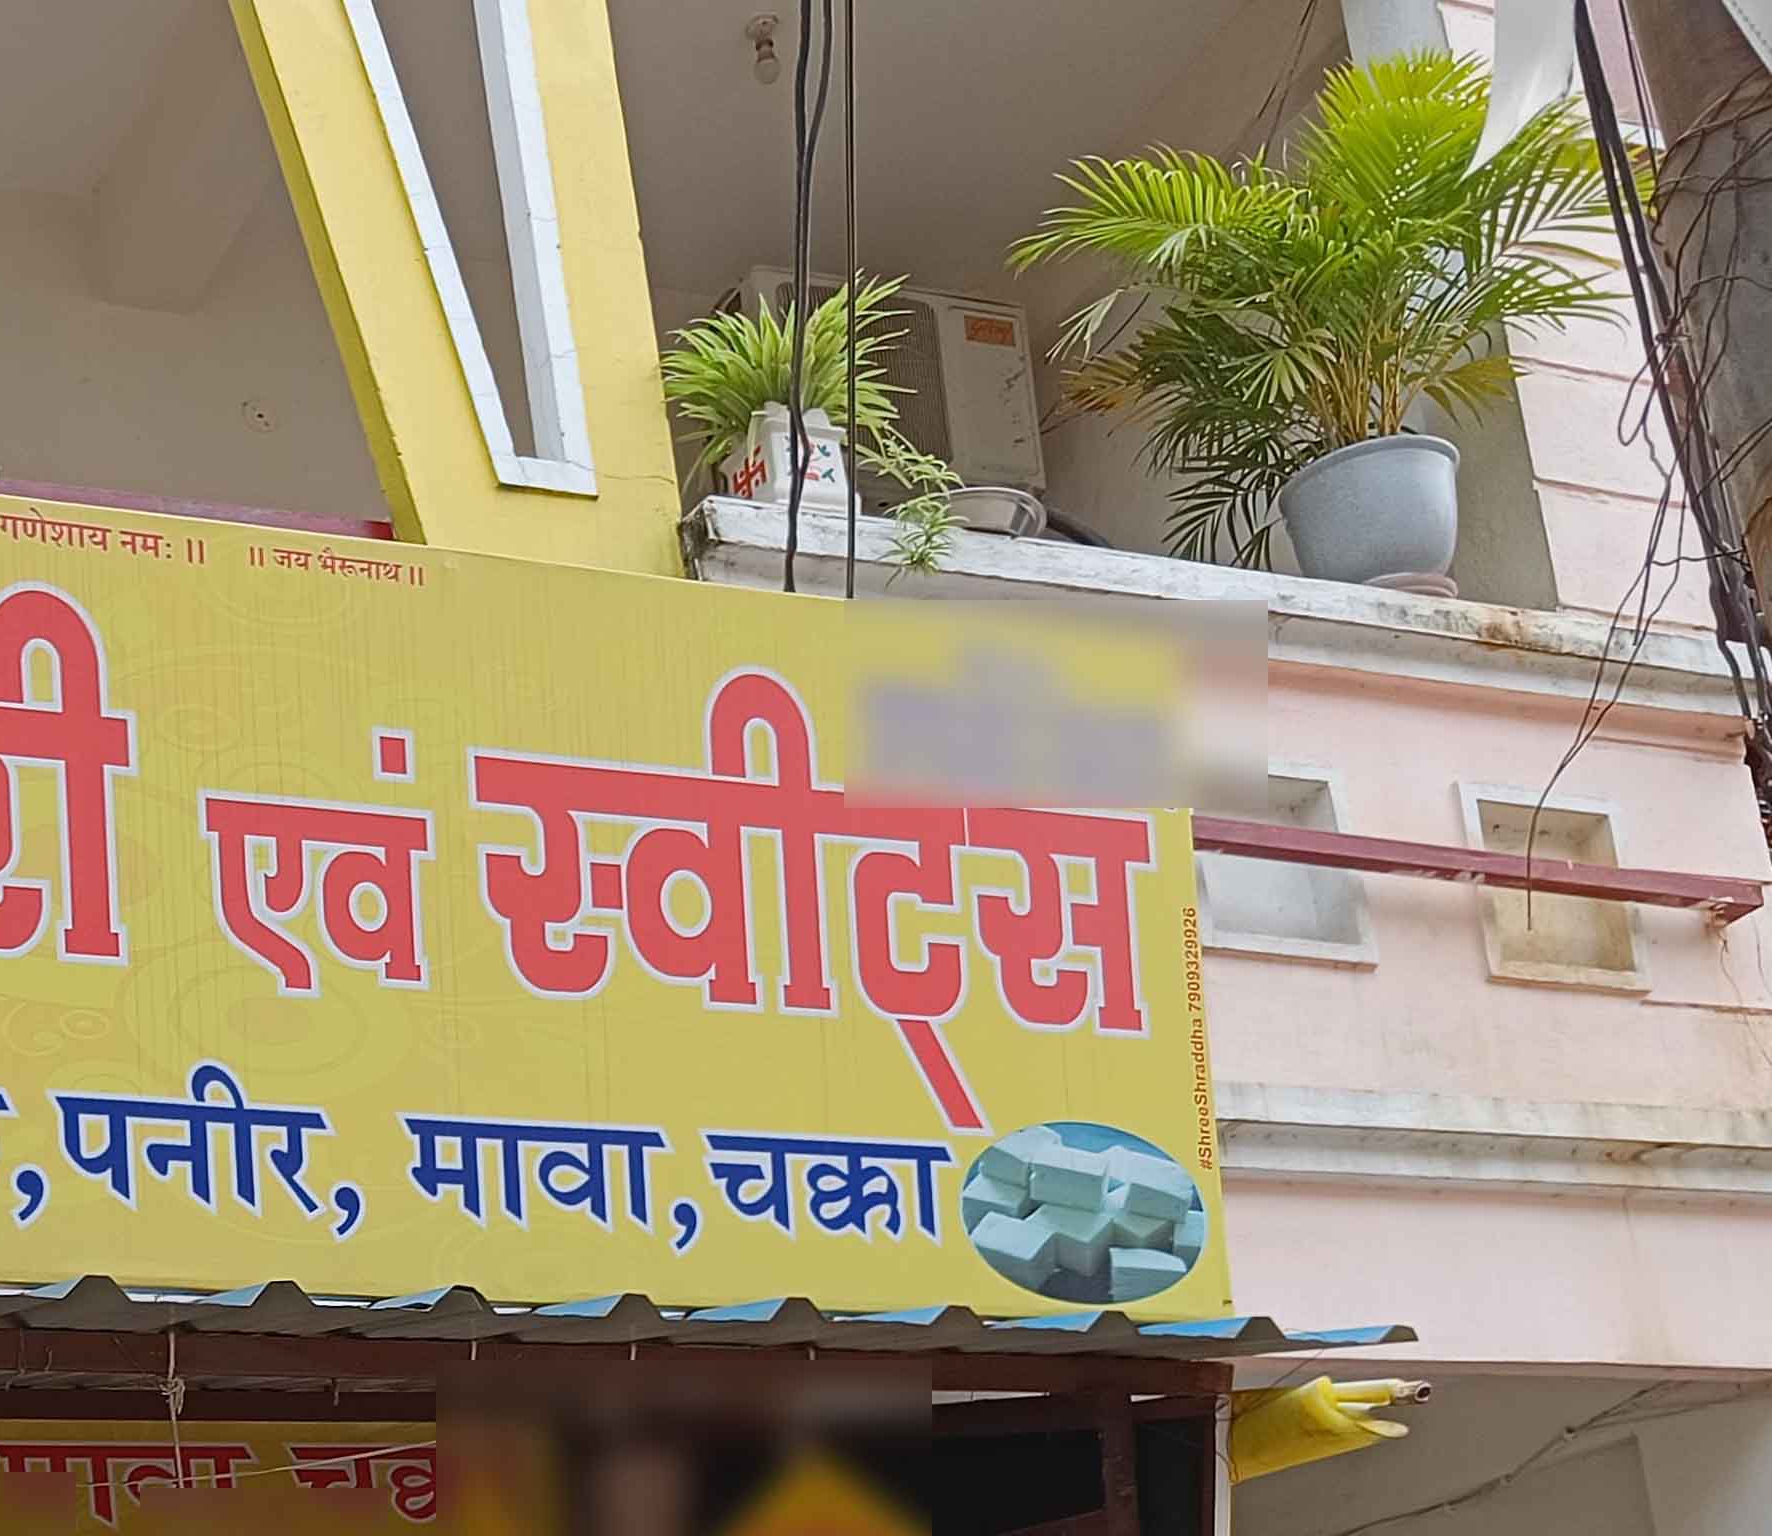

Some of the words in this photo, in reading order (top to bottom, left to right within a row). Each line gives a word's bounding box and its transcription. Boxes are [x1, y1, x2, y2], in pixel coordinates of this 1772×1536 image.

[0, 507, 112, 551] गणेशाय
[273, 548, 311, 569] जय
[205, 736, 429, 991] एवं
[472, 673, 1153, 1129] स्वीट्स
[705, 1134, 953, 1238] चक्का
